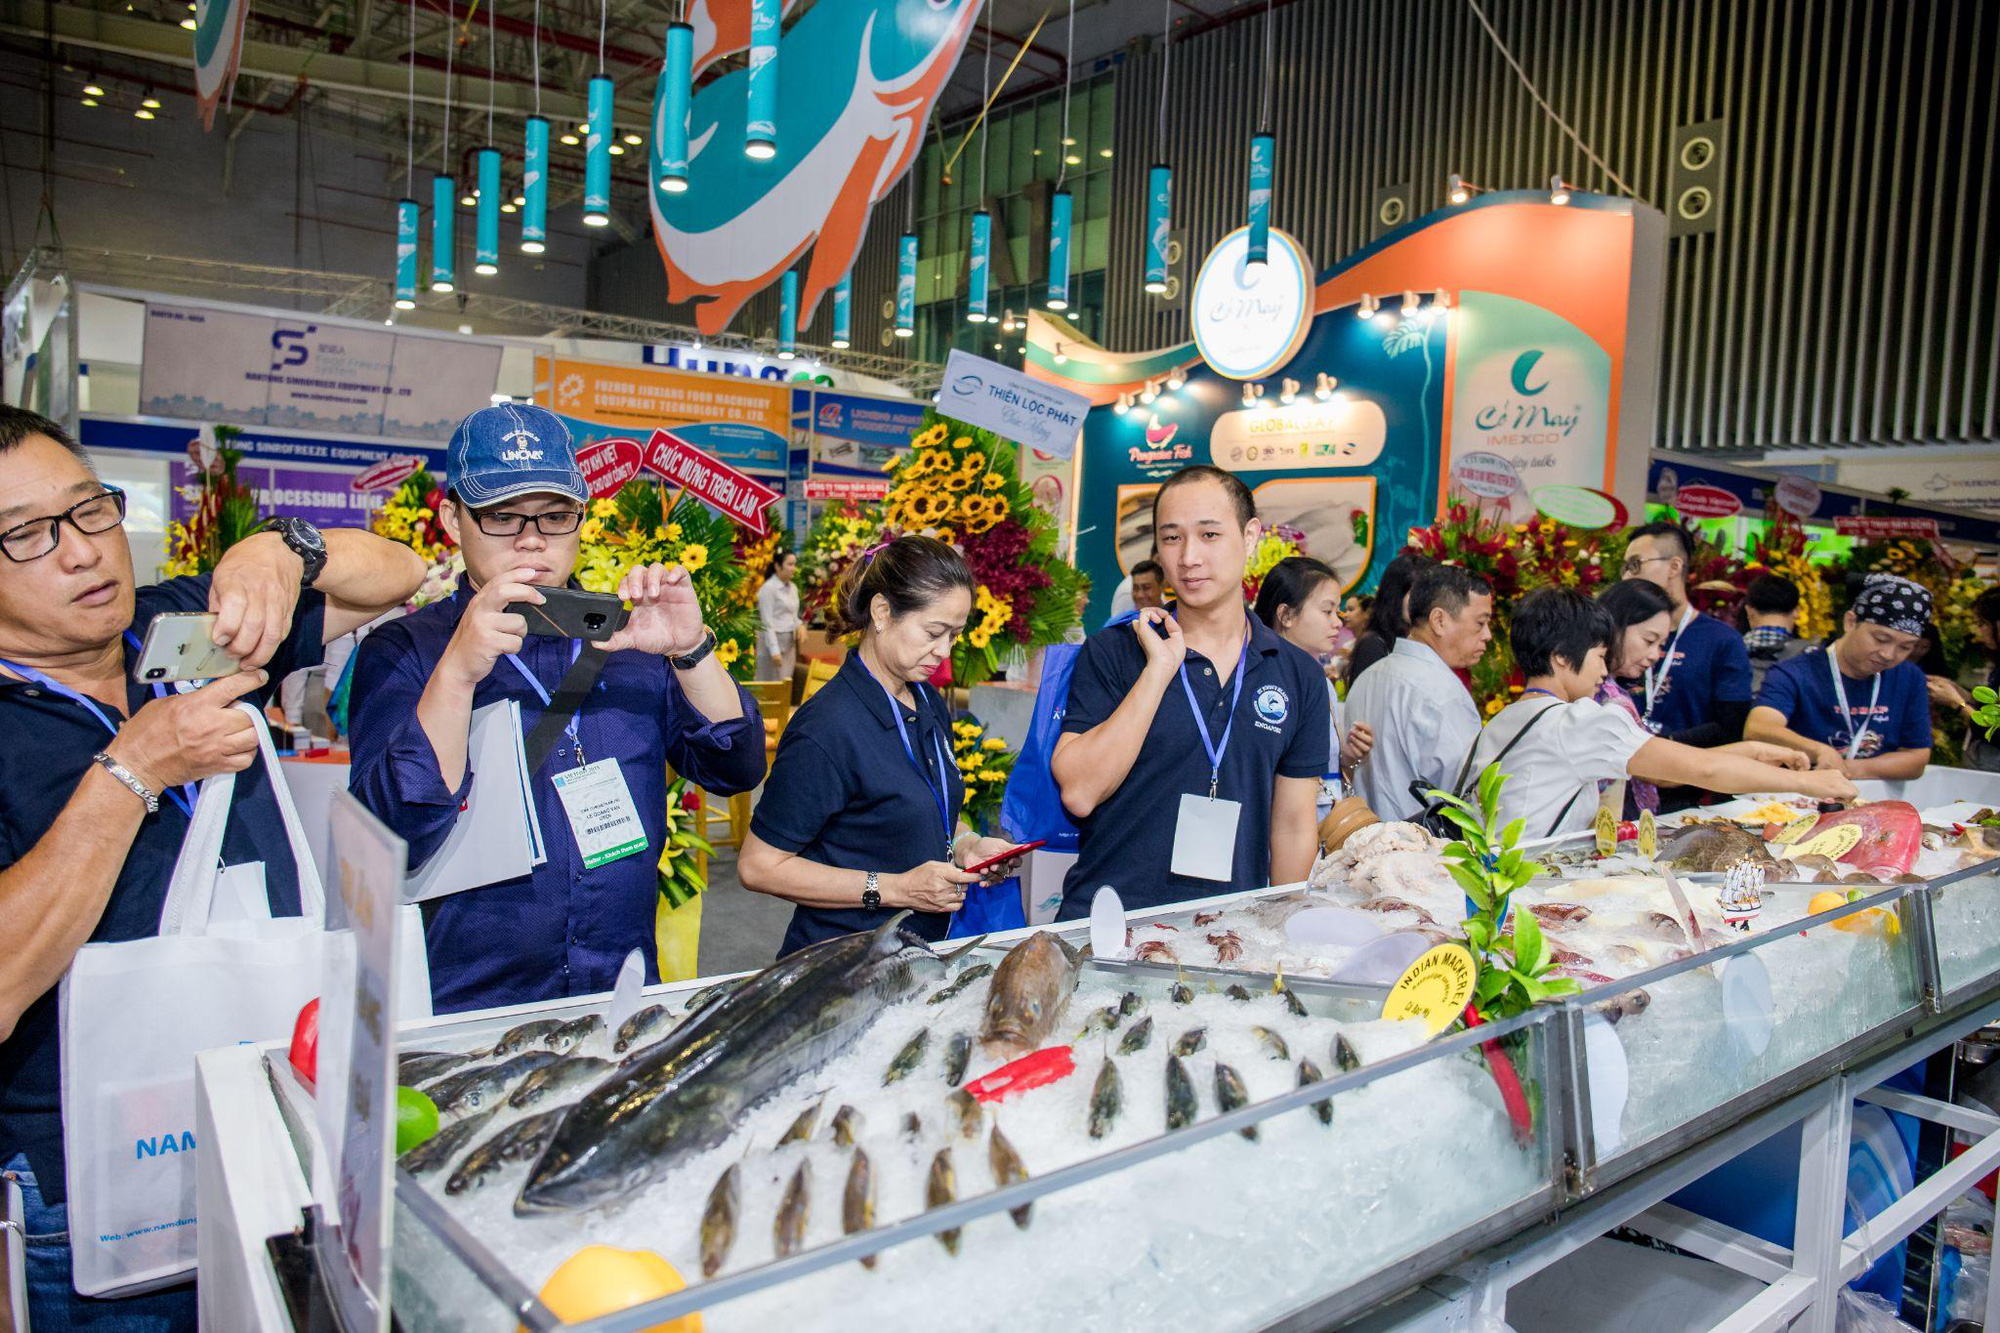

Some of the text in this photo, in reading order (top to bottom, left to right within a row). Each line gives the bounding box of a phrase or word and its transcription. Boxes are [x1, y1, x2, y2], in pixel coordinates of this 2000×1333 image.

[594, 394, 655, 411] EQUIPMENT
[989, 384, 1019, 406] THIÊN
[1046, 407, 1078, 427] PHÁT
[1487, 433, 1560, 446] IMEXCO
[652, 442, 680, 473] CHÚC
[677, 457, 708, 489] MỪNG
[706, 472, 737, 506] TRIỂN
[1400, 954, 1439, 990] INDIAN
[1441, 952, 1468, 1007] MACKEREL
[136, 1130, 197, 1160] NAM
[100, 1233, 125, 1242] Web:
